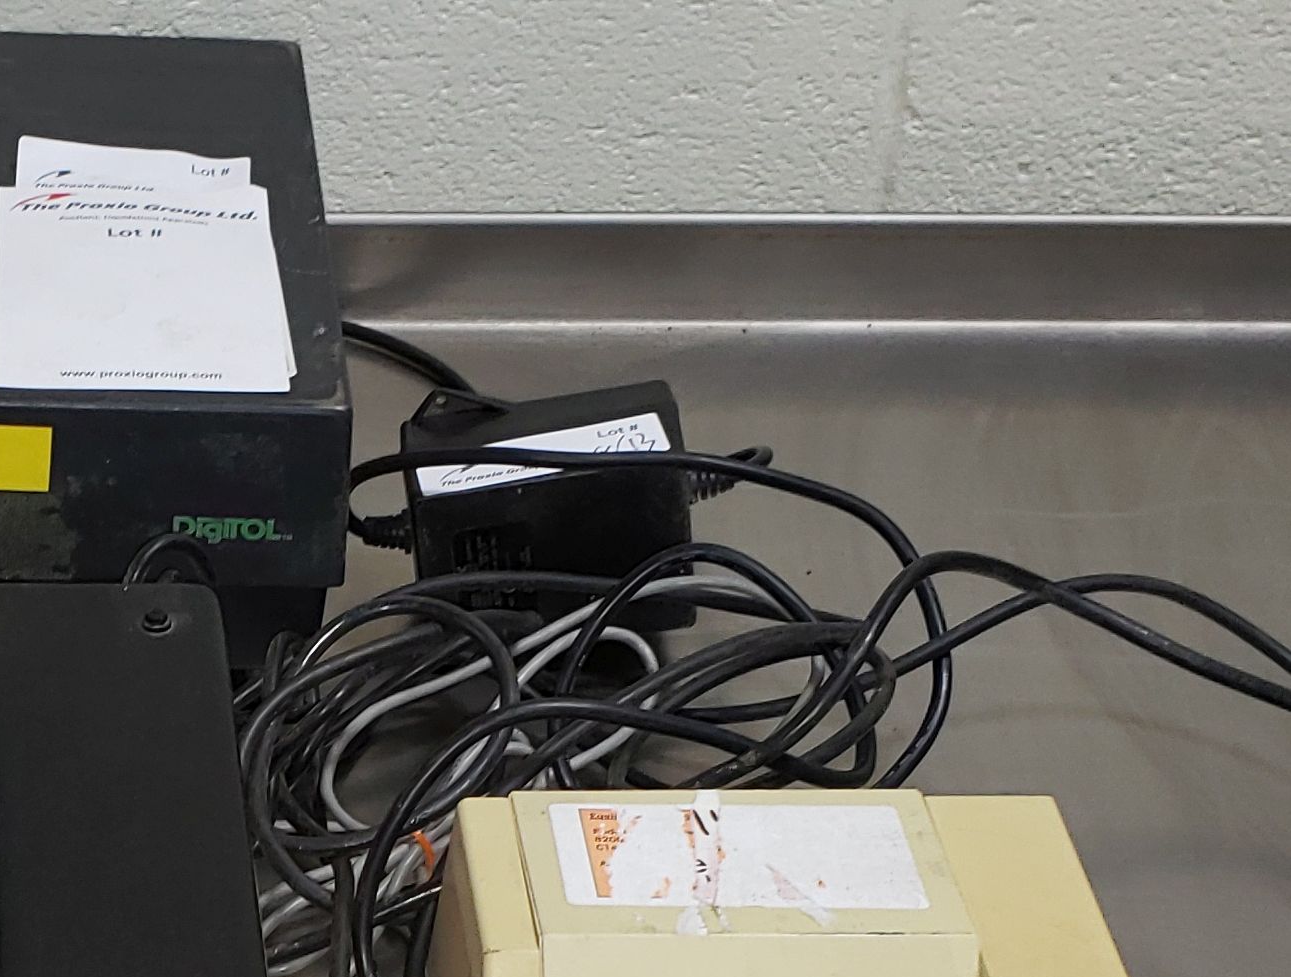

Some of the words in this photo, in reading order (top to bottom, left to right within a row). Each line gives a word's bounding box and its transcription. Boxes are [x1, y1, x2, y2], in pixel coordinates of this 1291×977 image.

[22, 202, 60, 211] The
[66, 201, 137, 211] Proxio
[144, 204, 211, 218] Group
[217, 210, 258, 221] Ltd.
[108, 228, 142, 237] Lot
